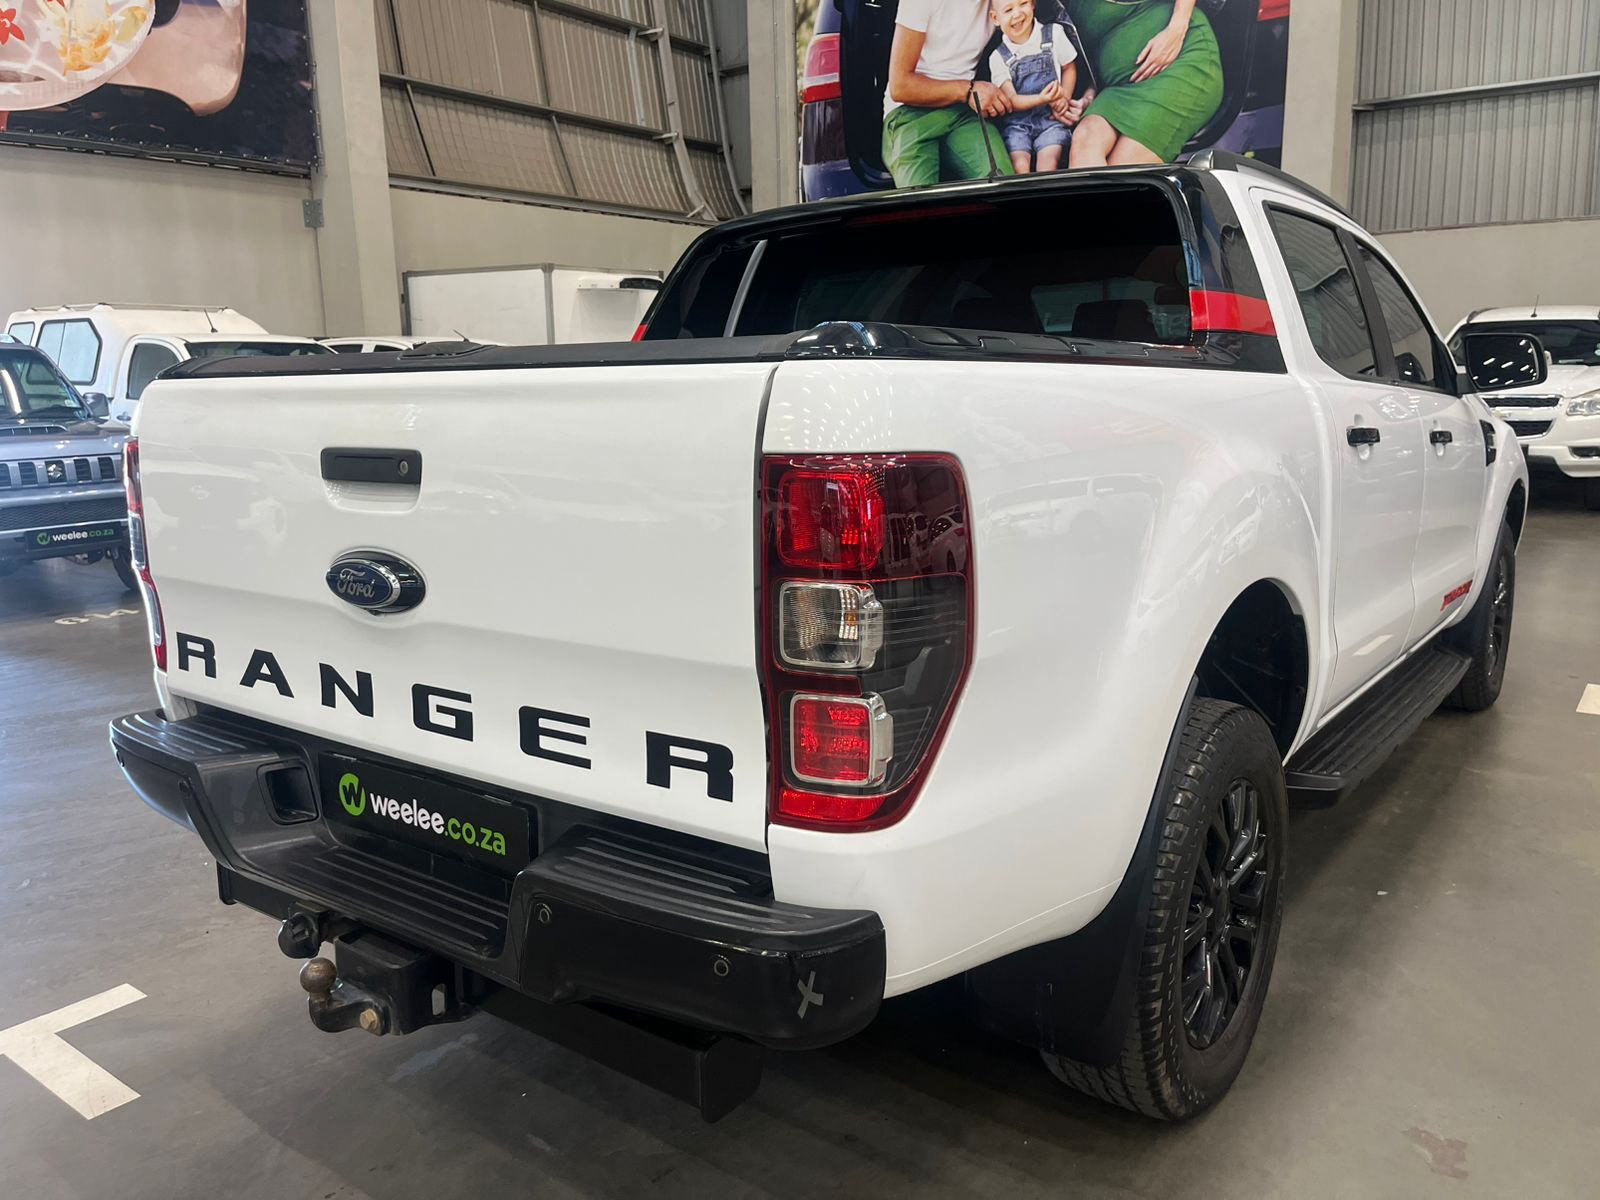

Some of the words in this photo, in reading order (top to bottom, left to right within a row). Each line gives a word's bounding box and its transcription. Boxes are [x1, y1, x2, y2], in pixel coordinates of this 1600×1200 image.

[52, 528, 114, 542] weelee.co.za
[337, 568, 375, 598] Ford
[176, 631, 734, 803] RANGER
[369, 792, 506, 856] weelee.co.za
